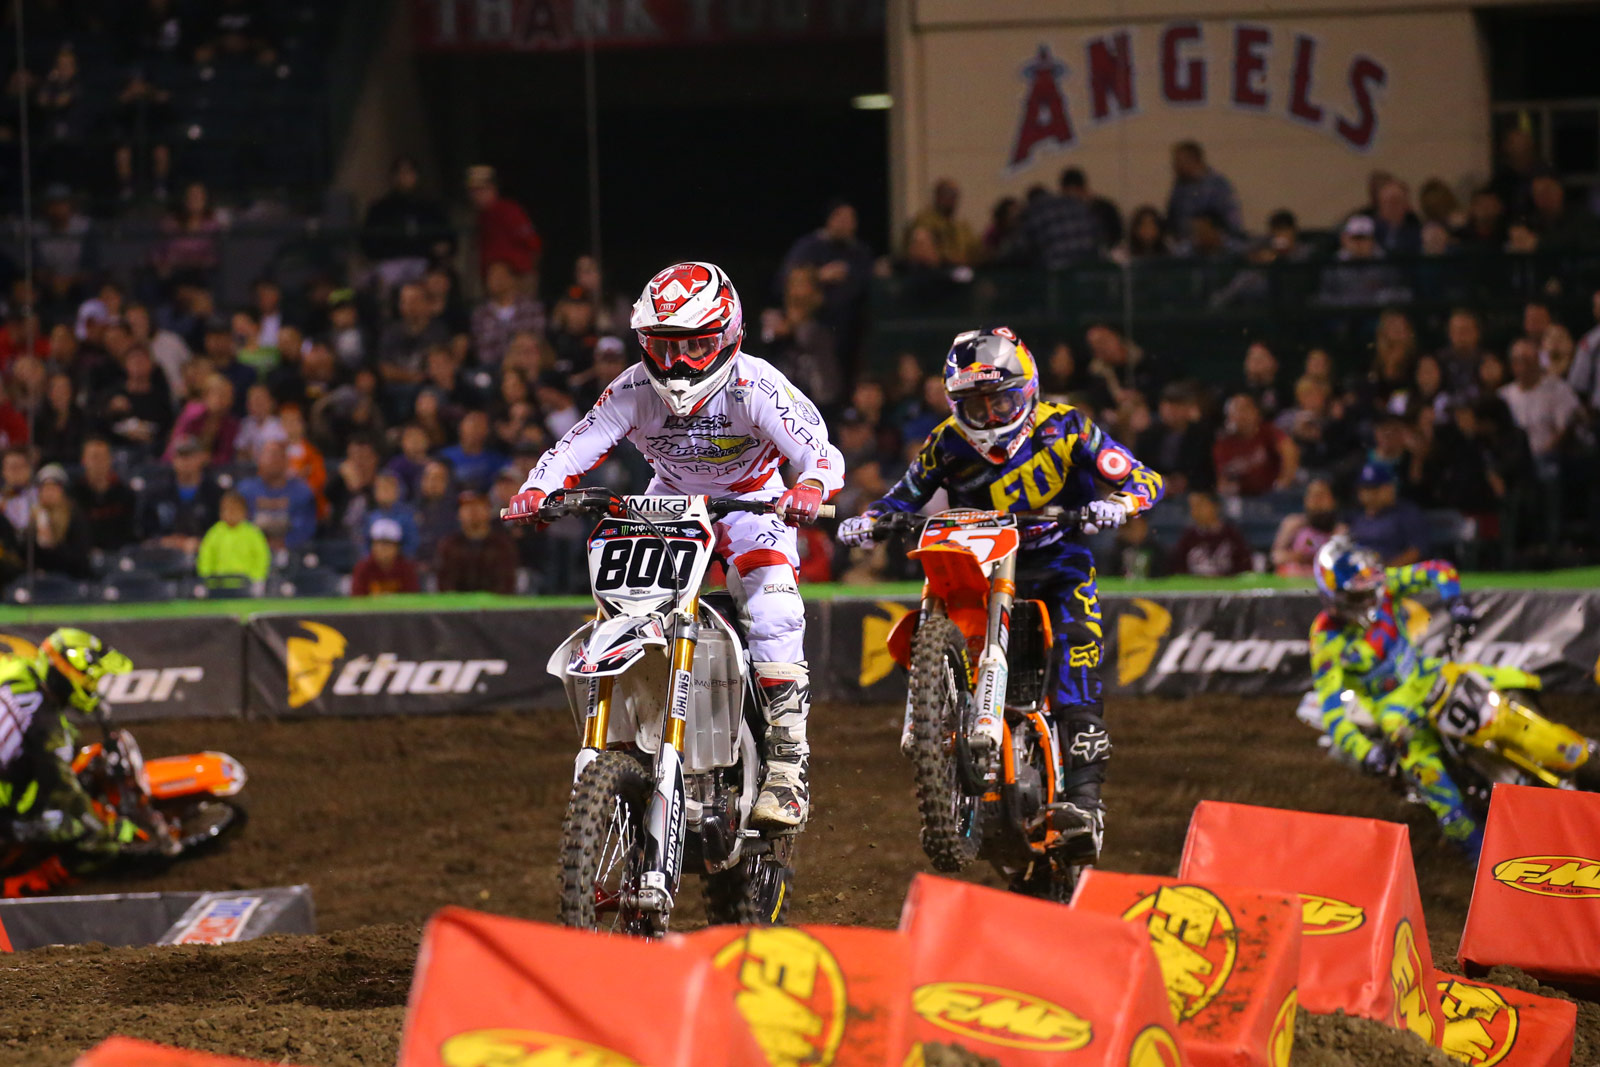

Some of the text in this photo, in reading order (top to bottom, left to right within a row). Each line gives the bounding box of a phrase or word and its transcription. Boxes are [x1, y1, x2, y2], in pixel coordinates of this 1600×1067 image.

[1005, 20, 1388, 172] ANGELS
[629, 497, 687, 515] Mika
[595, 538, 698, 591] 800
[946, 529, 1002, 564] 5
[332, 653, 508, 695] thor
[1156, 627, 1311, 674] thor
[97, 667, 204, 703] or
[672, 674, 690, 717] ÖHLINS
[666, 789, 680, 875] DUNLOP
[1494, 861, 1600, 889] FM
[1148, 886, 1219, 1020] FM
[735, 928, 823, 1062] FM
[913, 987, 1092, 1040] FMF
